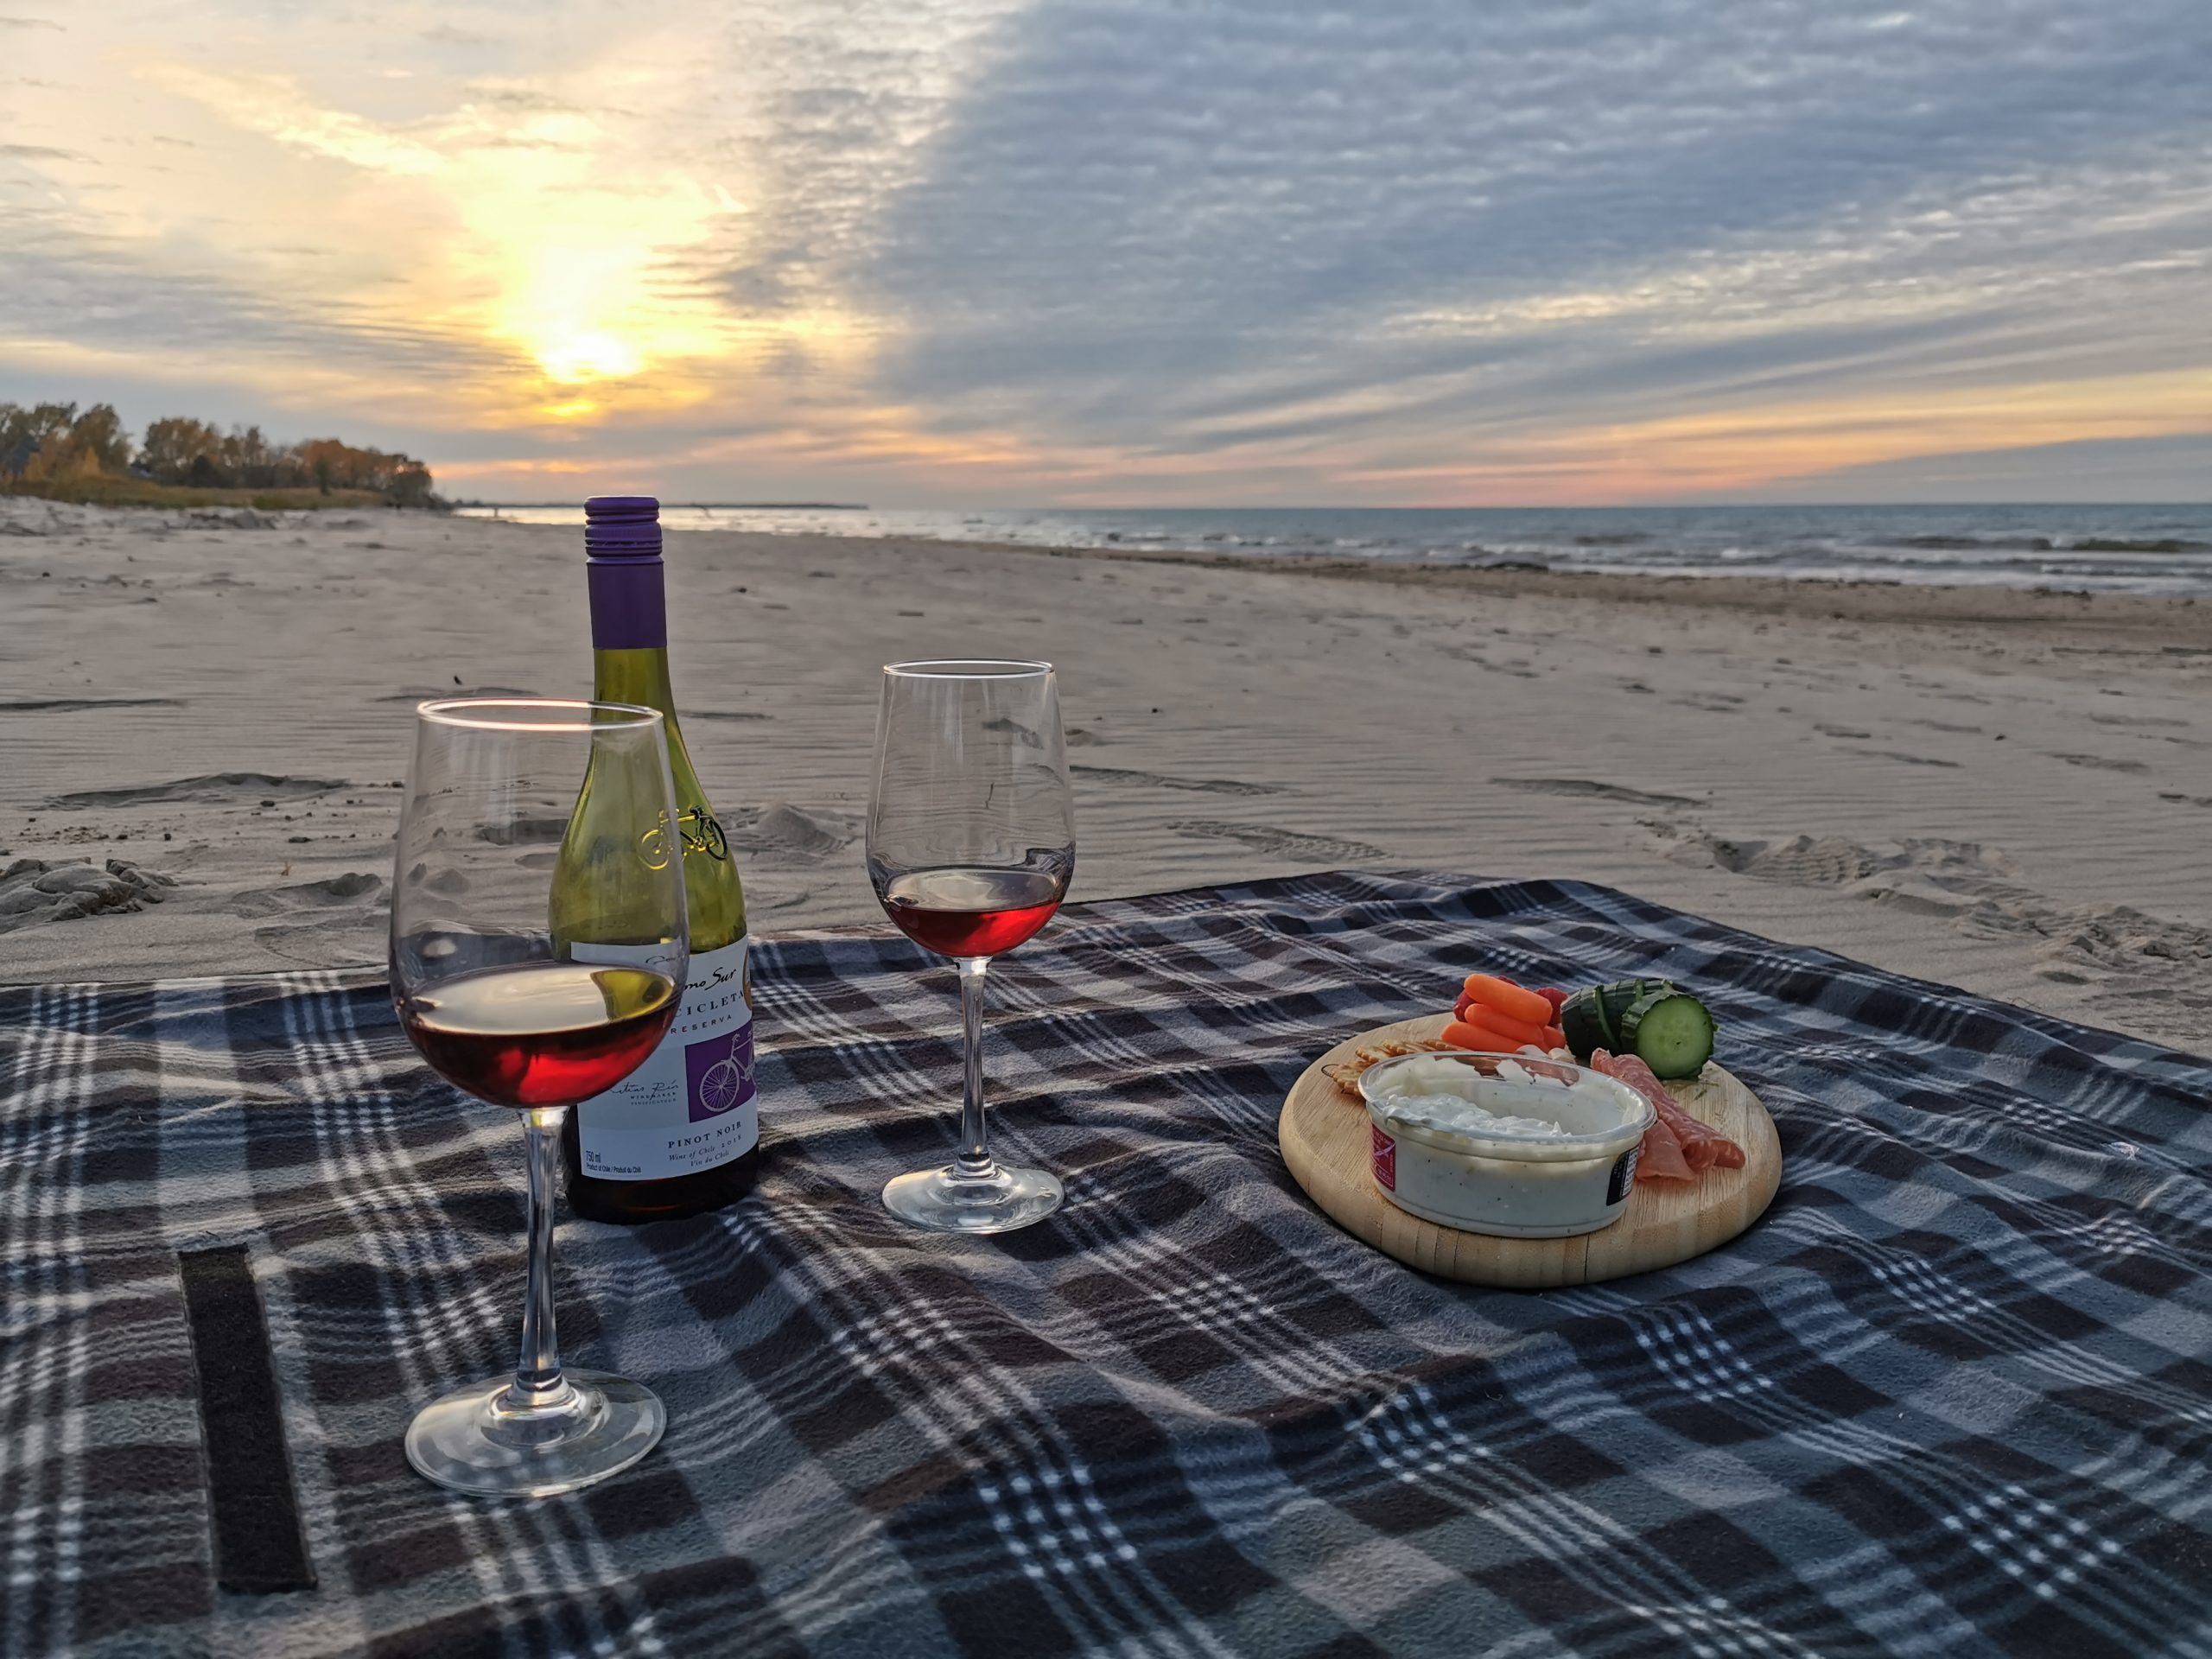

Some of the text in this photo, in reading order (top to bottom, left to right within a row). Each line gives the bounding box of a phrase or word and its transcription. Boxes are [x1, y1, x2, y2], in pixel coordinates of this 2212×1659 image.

[705, 967, 737, 991] Sur
[671, 1014, 732, 1034] RESERVA
[668, 1121, 741, 1148] PINOT NOIR
[586, 1150, 601, 1163] 750 ml
[689, 1151, 696, 1160] of
[698, 1145, 715, 1155] Chile
[715, 1150, 729, 1160] Chili
[586, 1162, 598, 1171] Product
